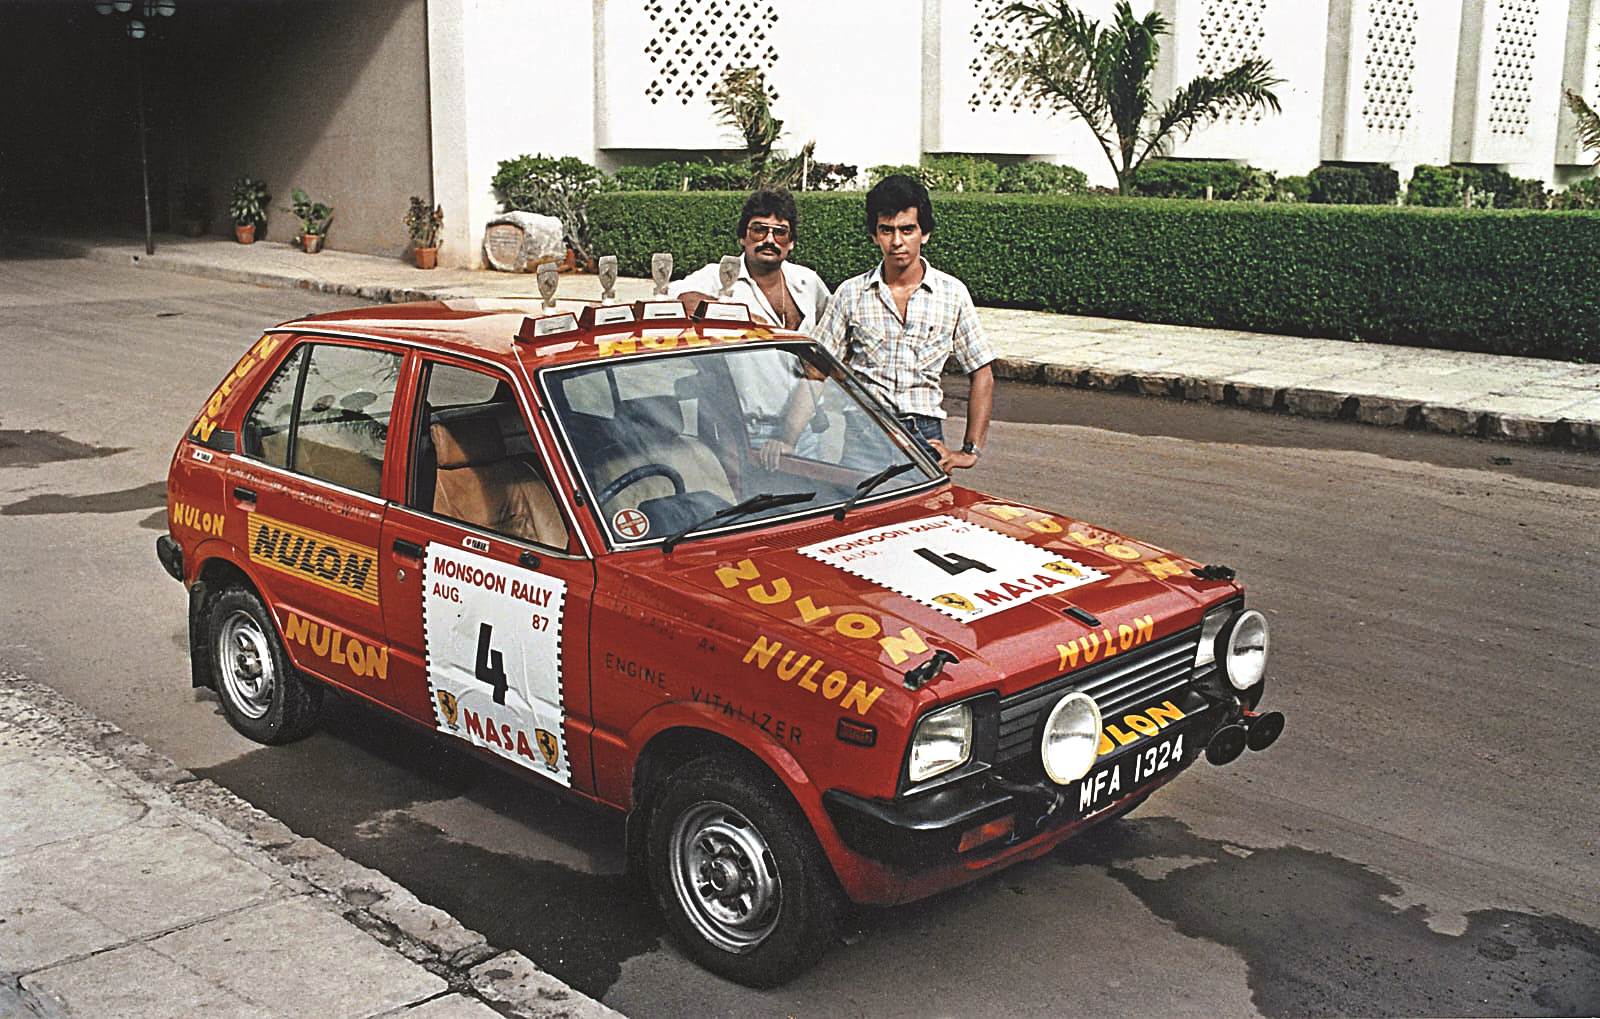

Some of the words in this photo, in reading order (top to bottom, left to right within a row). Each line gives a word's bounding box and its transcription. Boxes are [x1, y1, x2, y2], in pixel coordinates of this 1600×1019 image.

[192, 335, 279, 442] NULON
[172, 502, 225, 537] NULON
[819, 529, 909, 556] MONSOON
[909, 519, 953, 534] RALLY
[988, 505, 1184, 580] NULON
[254, 524, 372, 591] NULON
[433, 556, 507, 596] MONSOON
[510, 580, 553, 608] RALLY
[913, 547, 997, 576] 4
[432, 586, 463, 604] AUG.
[714, 558, 929, 666] NULON
[974, 574, 1066, 606] MASA
[286, 612, 390, 680] NULON
[531, 613, 550, 633] 87
[1056, 615, 1154, 672] NULON
[474, 622, 509, 706] 4
[743, 635, 885, 716] NULON
[606, 652, 667, 689] ENGINE
[690, 686, 803, 744] VITALIZER
[464, 707, 536, 762] MASA
[1079, 764, 1121, 812] MFA
[1134, 733, 1184, 783] 1324
